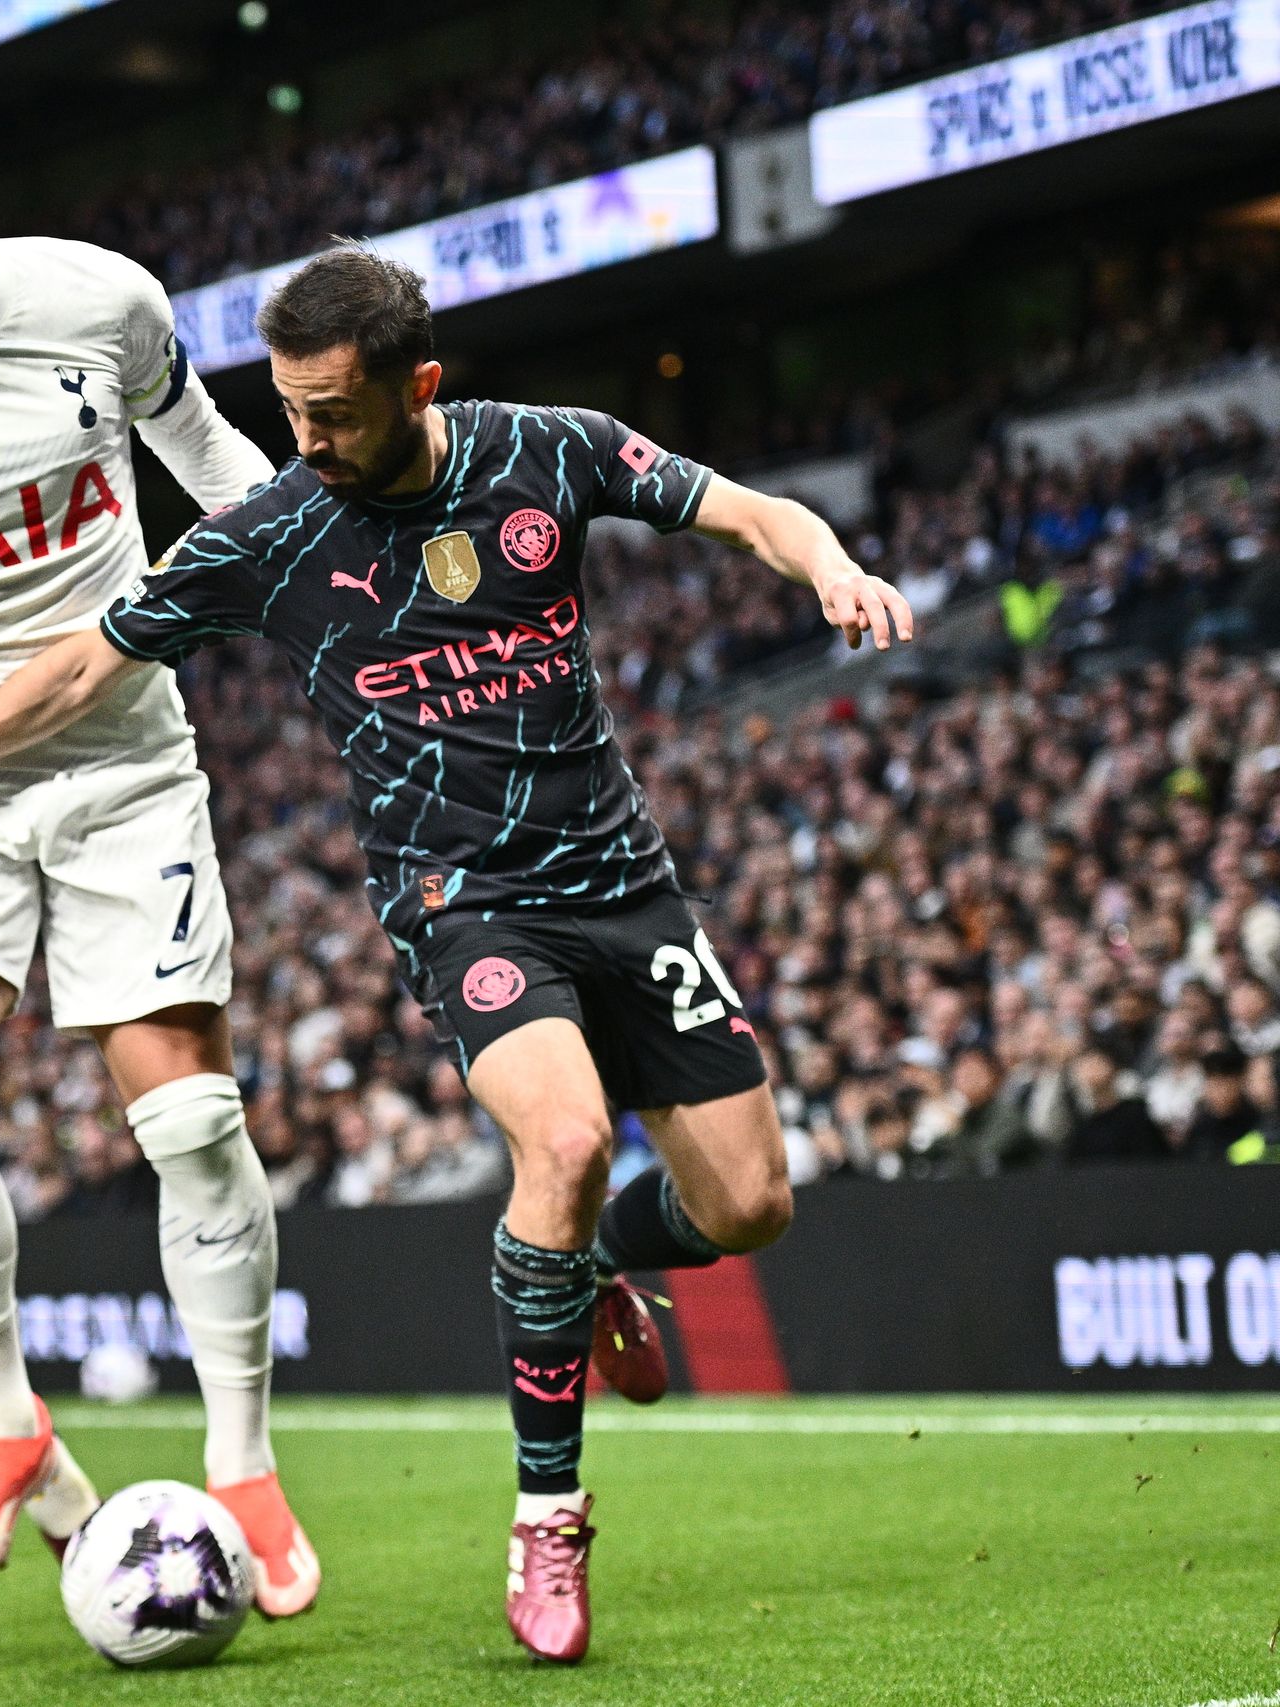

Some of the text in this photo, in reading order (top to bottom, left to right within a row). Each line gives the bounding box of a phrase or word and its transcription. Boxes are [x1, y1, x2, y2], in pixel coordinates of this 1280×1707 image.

[504, 512, 550, 541] MANCHESTER
[445, 574, 469, 588] FIFA
[354, 594, 579, 699] ETIHAD
[418, 651, 571, 726] AIRWAYS
[160, 862, 195, 941] 7
[1053, 1251, 1280, 1368] BUILT O
